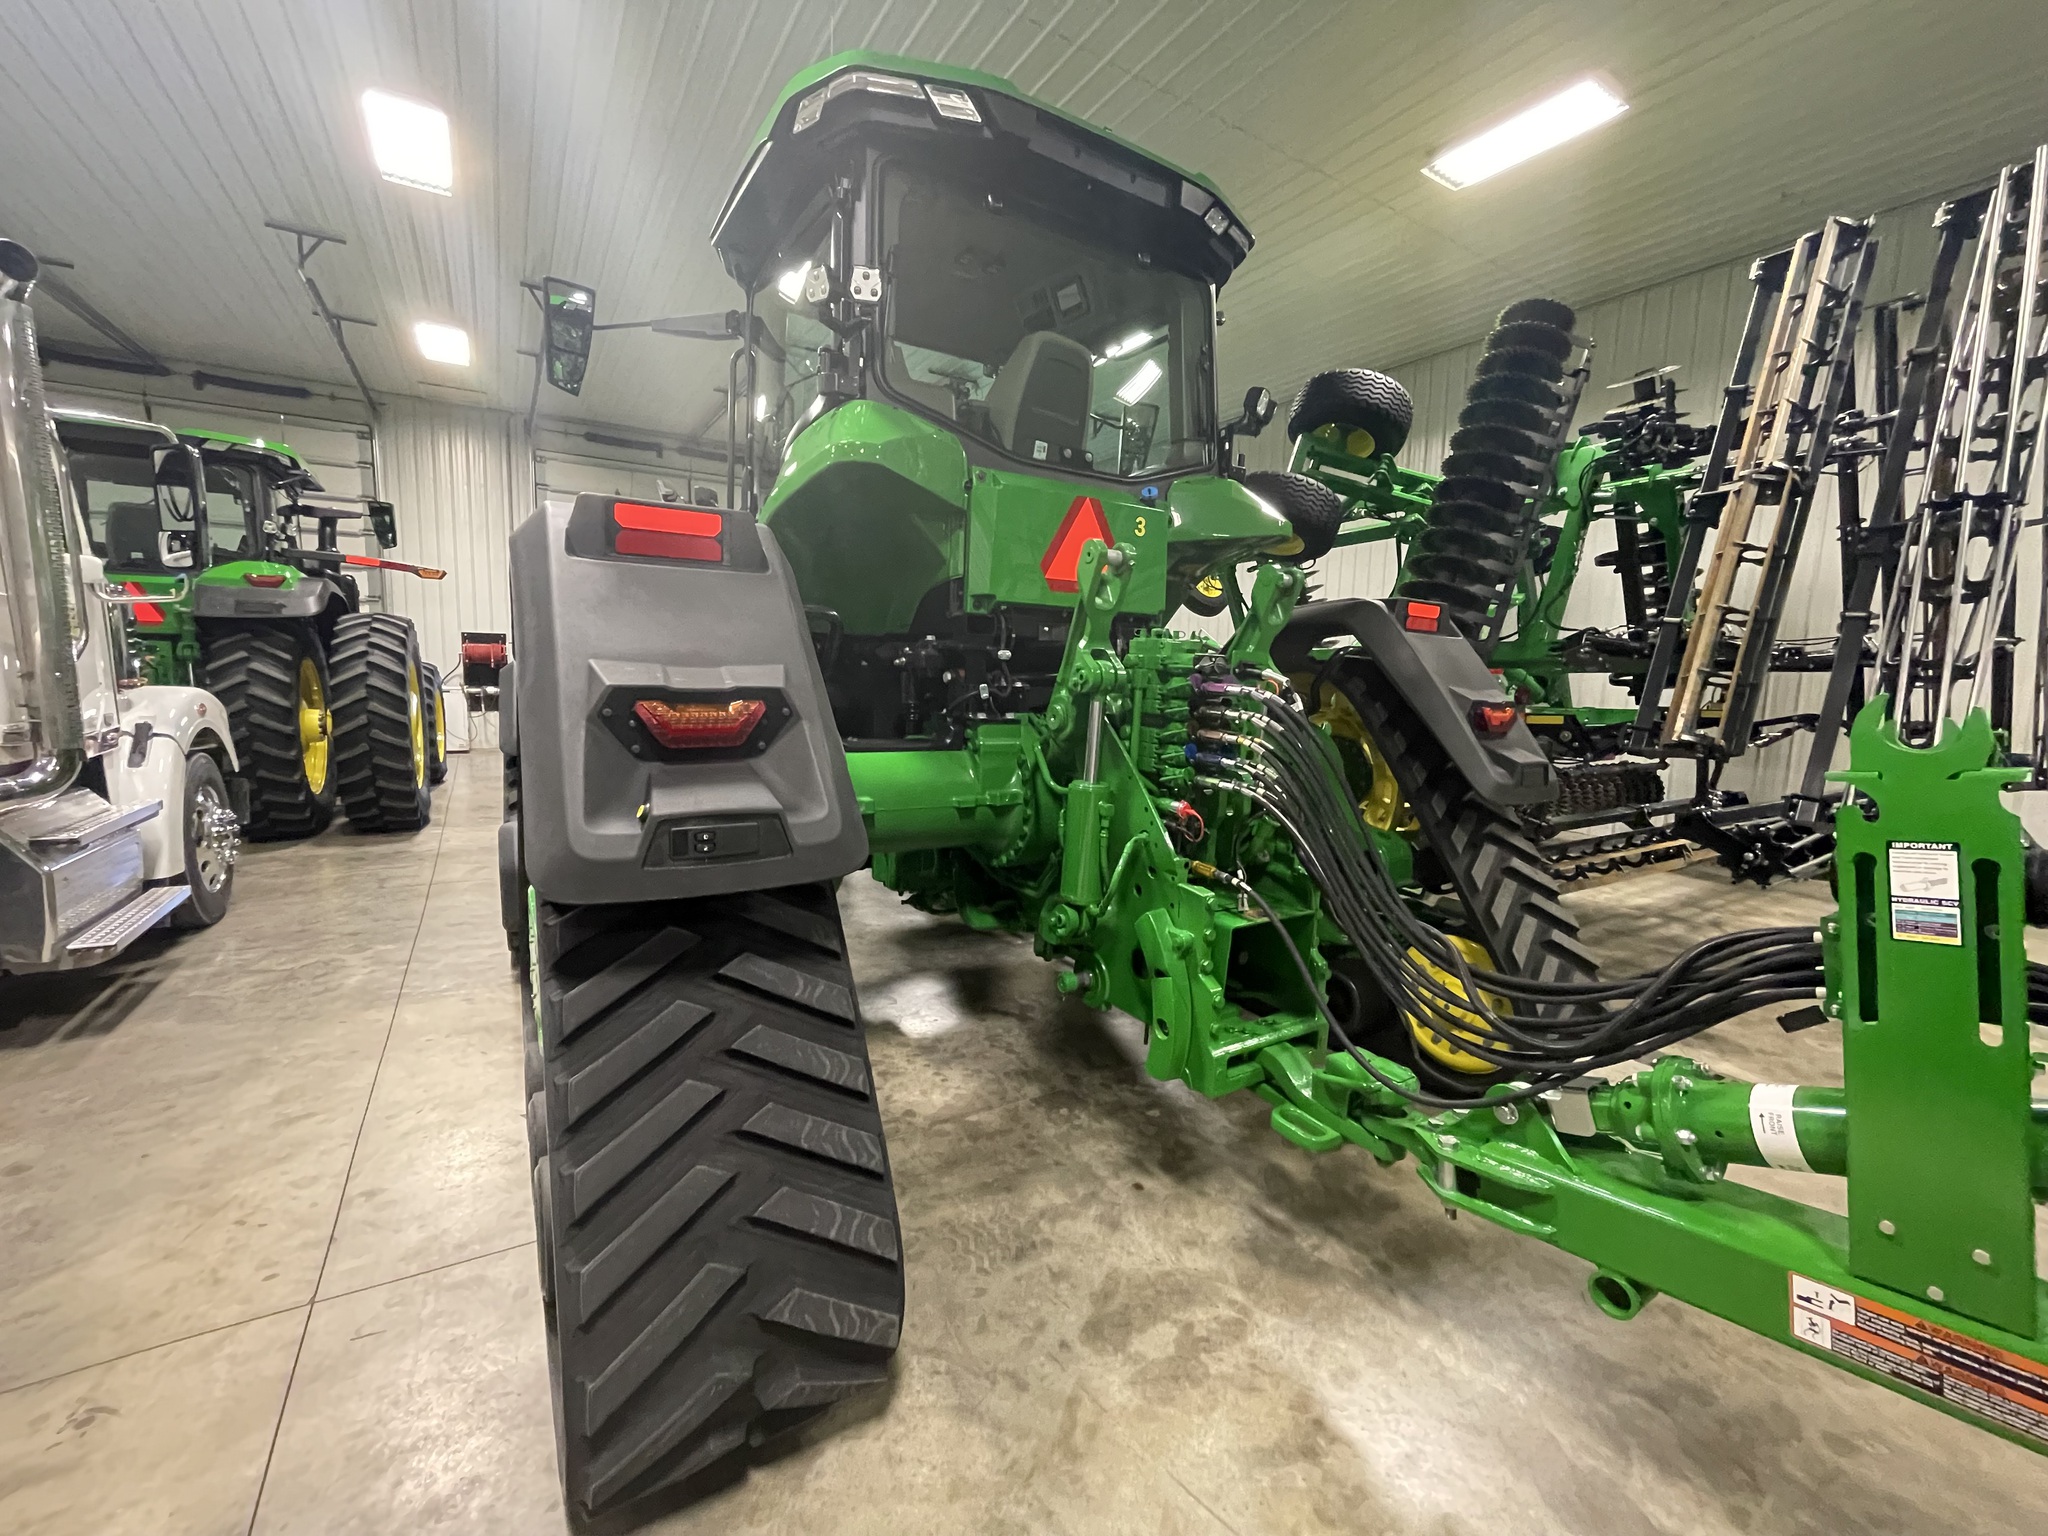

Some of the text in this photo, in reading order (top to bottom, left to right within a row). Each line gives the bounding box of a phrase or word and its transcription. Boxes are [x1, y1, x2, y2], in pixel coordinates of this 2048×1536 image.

[1134, 516, 1147, 537] 3
[1891, 842, 1953, 850] IMPORTANT
[1891, 896, 1939, 905] HYDRAULIC
[1768, 1112, 1777, 1135] FRONT
[1775, 1113, 1785, 1135] RAISE
